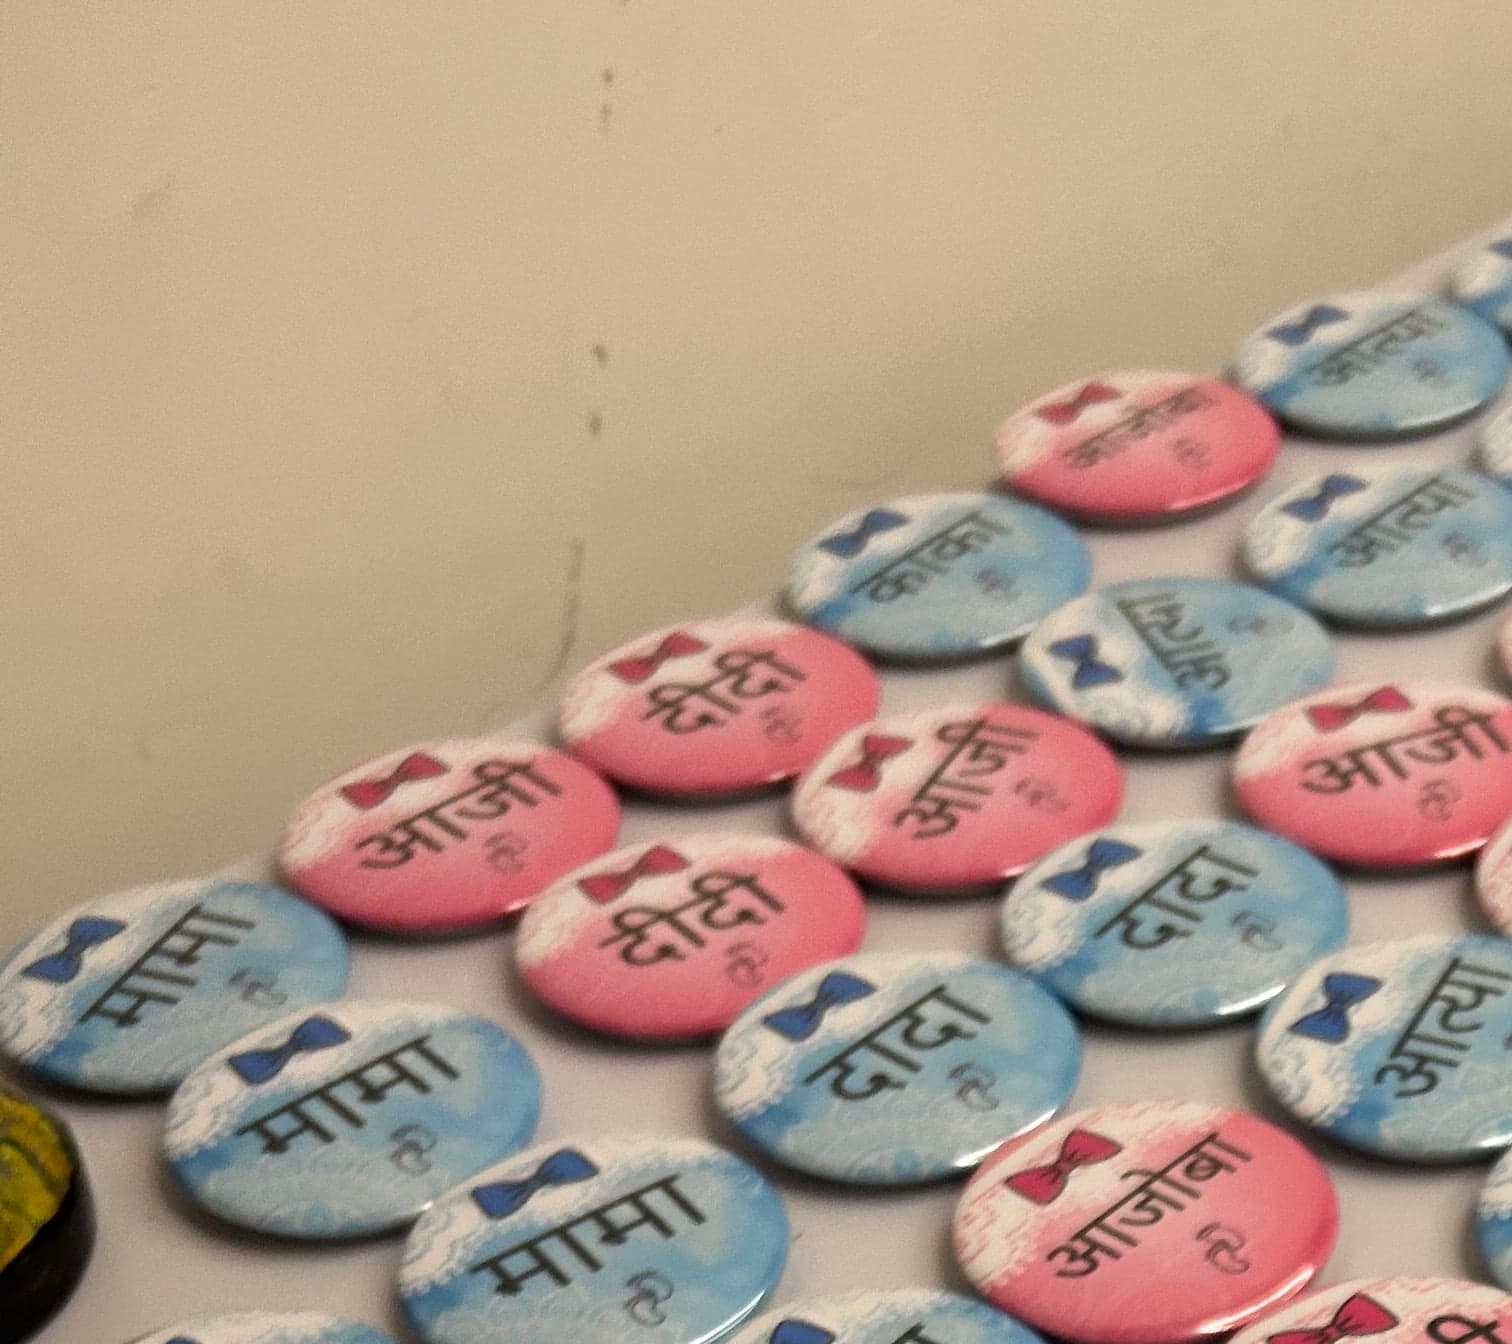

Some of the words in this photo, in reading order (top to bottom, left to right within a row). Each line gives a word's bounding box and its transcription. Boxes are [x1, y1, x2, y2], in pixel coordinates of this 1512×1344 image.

[847, 511, 1012, 604] काका
[1323, 474, 1479, 568] आत्या
[642, 648, 807, 735] दीदी
[895, 718, 1043, 840] आजी
[1300, 703, 1512, 794] आजी
[357, 760, 563, 869] आजी
[600, 869, 785, 969] दीदी
[1097, 845, 1262, 950] दादा
[79, 903, 258, 1028] मामा
[237, 1035, 463, 1154] मामा
[803, 984, 993, 1100] दादा
[468, 1175, 708, 1297] मामा
[1046, 1131, 1254, 1279] आजोबा
